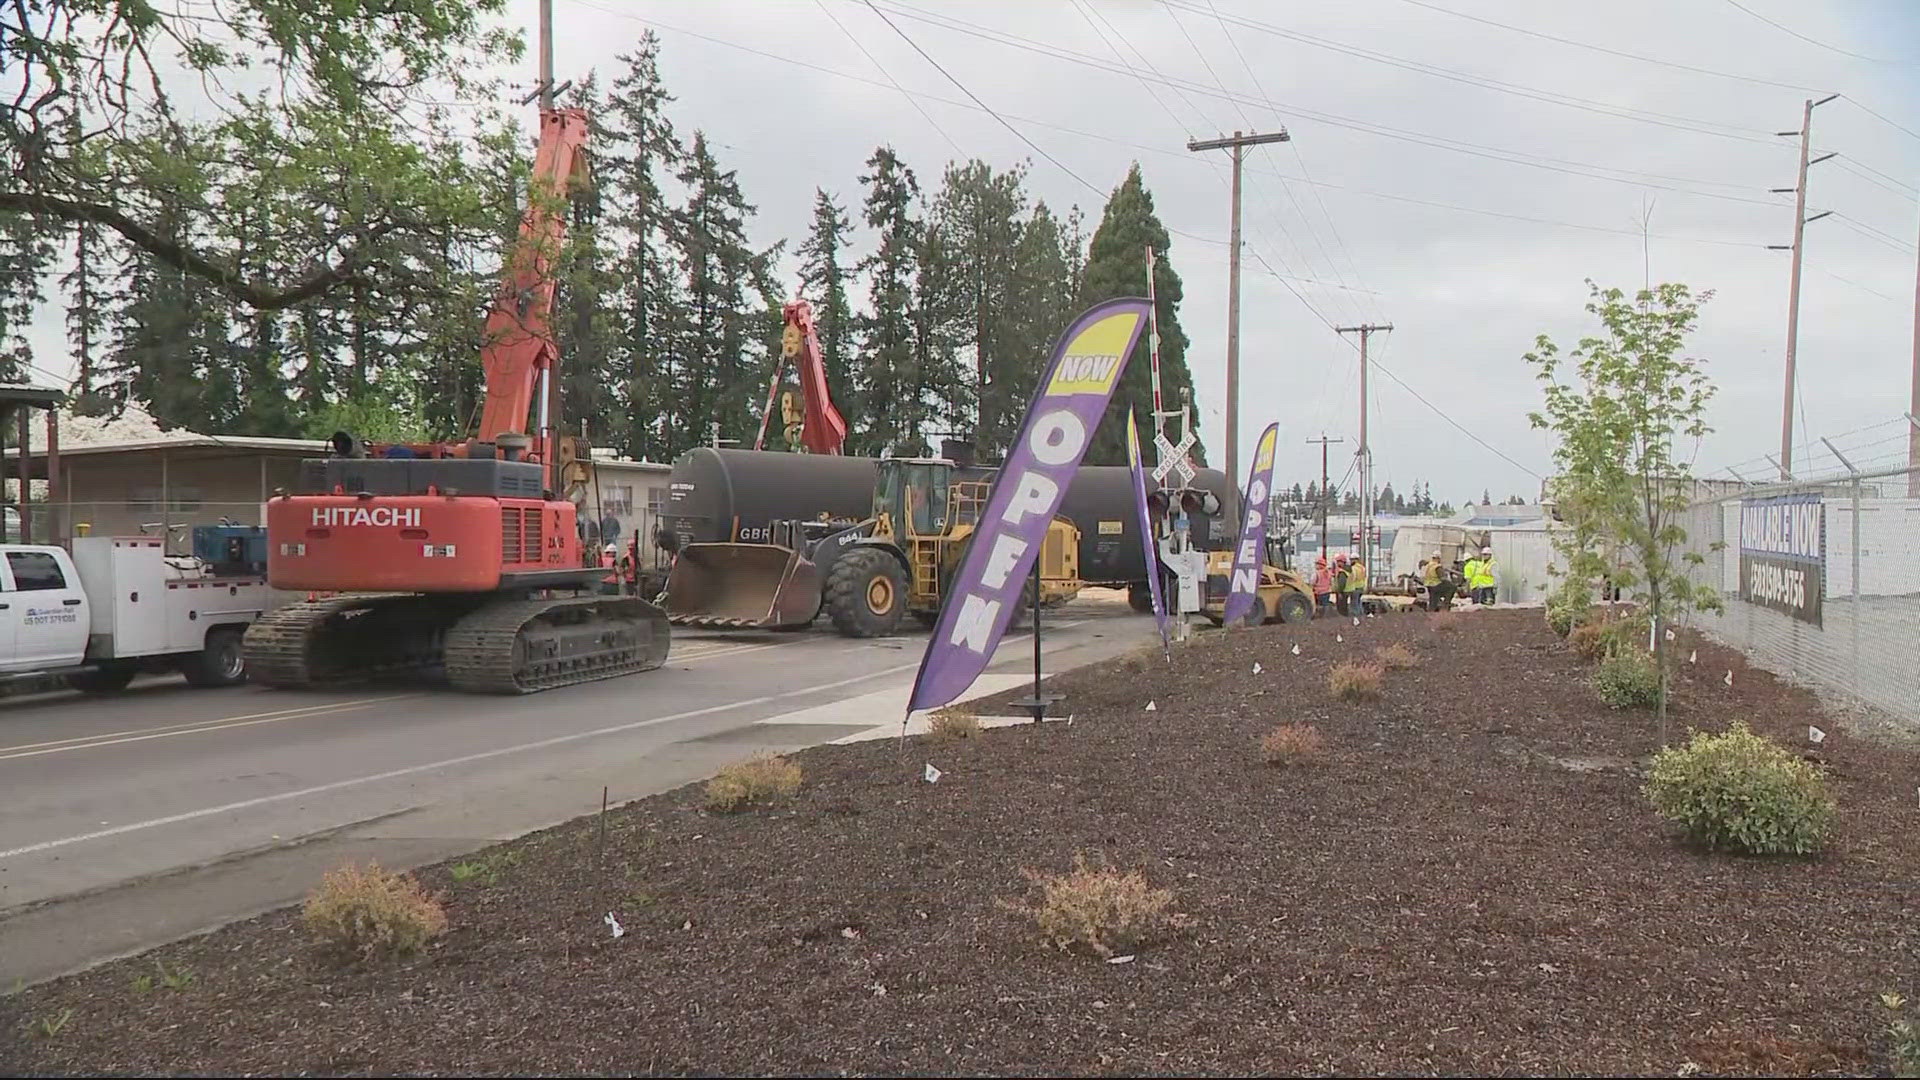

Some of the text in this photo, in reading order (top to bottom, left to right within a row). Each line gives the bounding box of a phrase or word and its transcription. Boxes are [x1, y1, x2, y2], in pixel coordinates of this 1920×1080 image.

[1057, 354, 1118, 383] NOW
[1154, 435, 1193, 478] CROSSING
[1156, 434, 1171, 454] RAIL
[1175, 459, 1193, 480] ROAD
[312, 507, 421, 527] HITACHI
[950, 409, 1086, 654] OPEN
[1741, 502, 1822, 557] AVAILABLE NOW
[1231, 479, 1267, 594] OPEN
